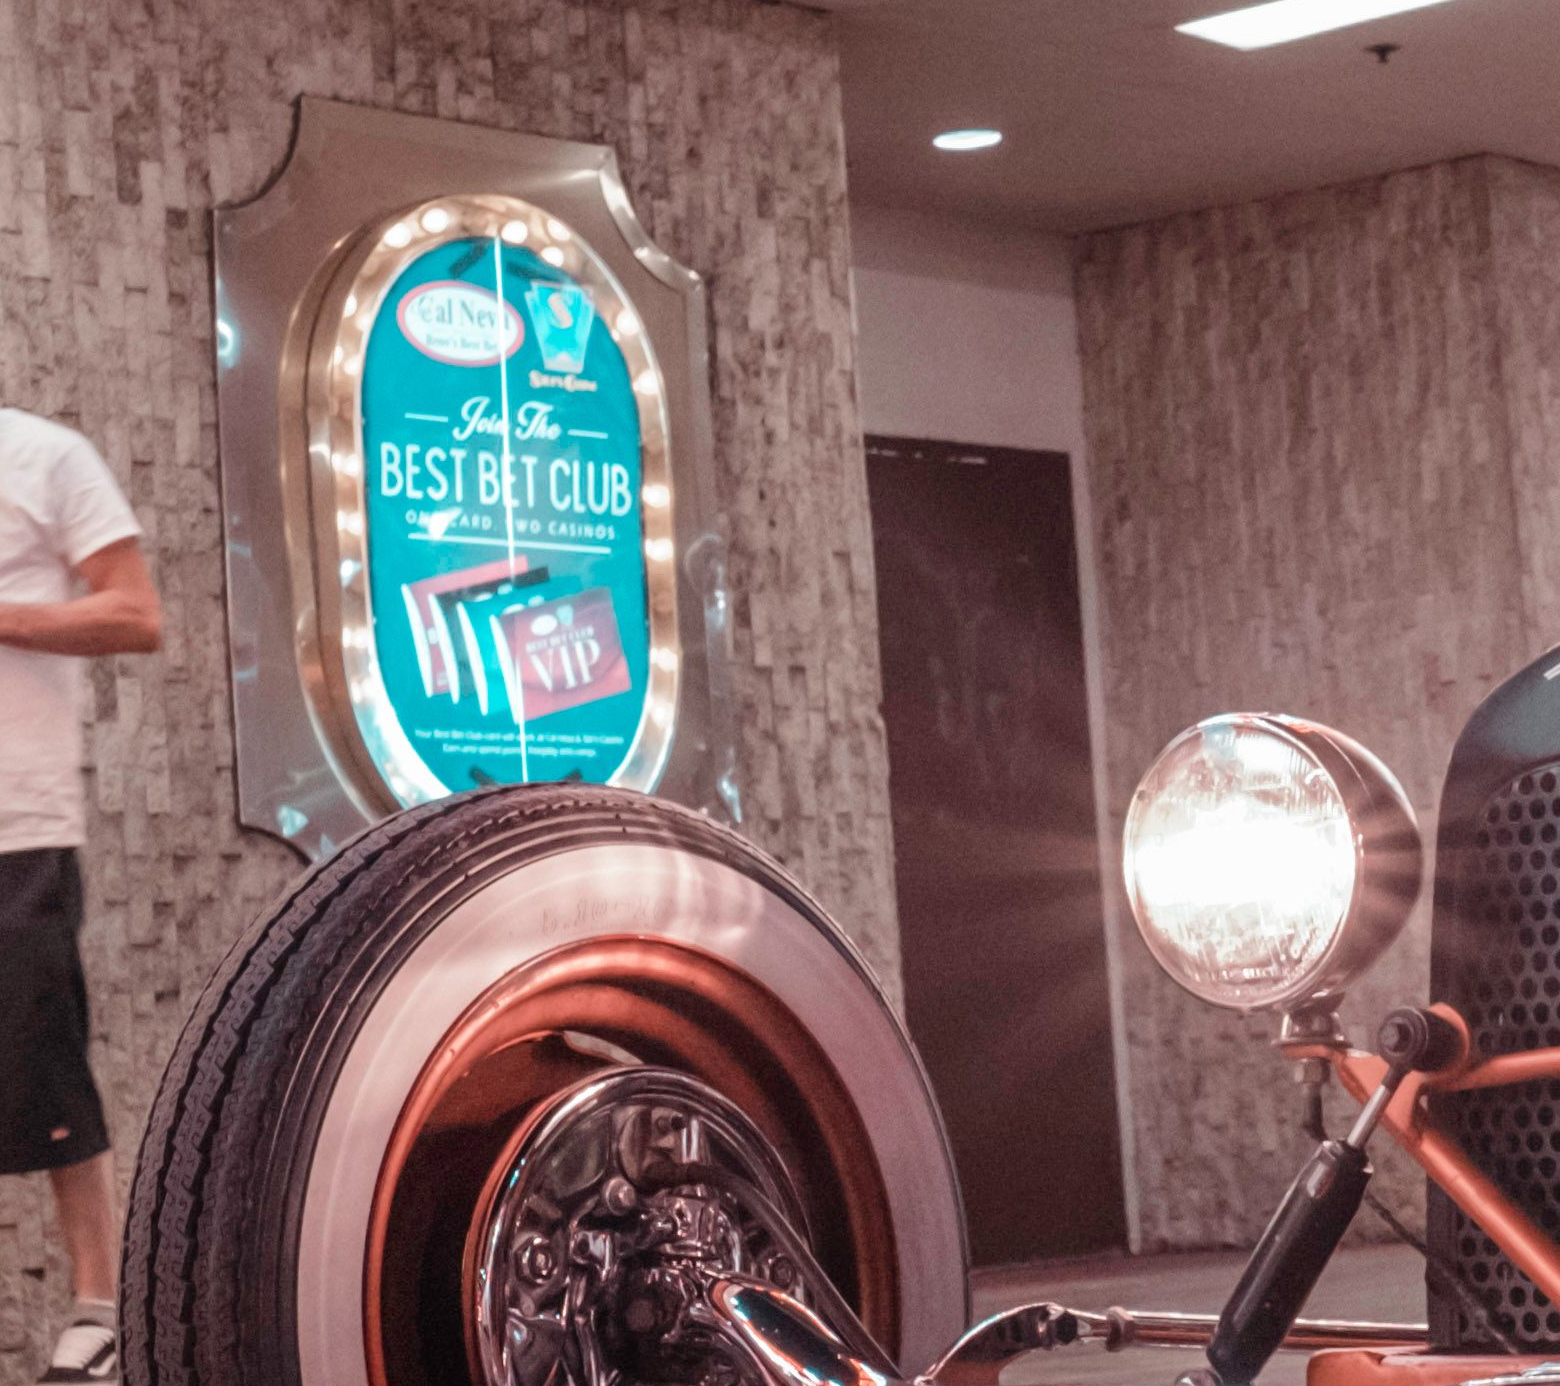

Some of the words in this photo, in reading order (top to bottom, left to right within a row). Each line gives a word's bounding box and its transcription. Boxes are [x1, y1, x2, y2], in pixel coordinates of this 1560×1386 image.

[514, 400, 562, 441] The
[380, 442, 467, 502] BEST
[478, 450, 538, 508] BET
[549, 458, 632, 517] CLUB
[530, 638, 600, 693] VIP
